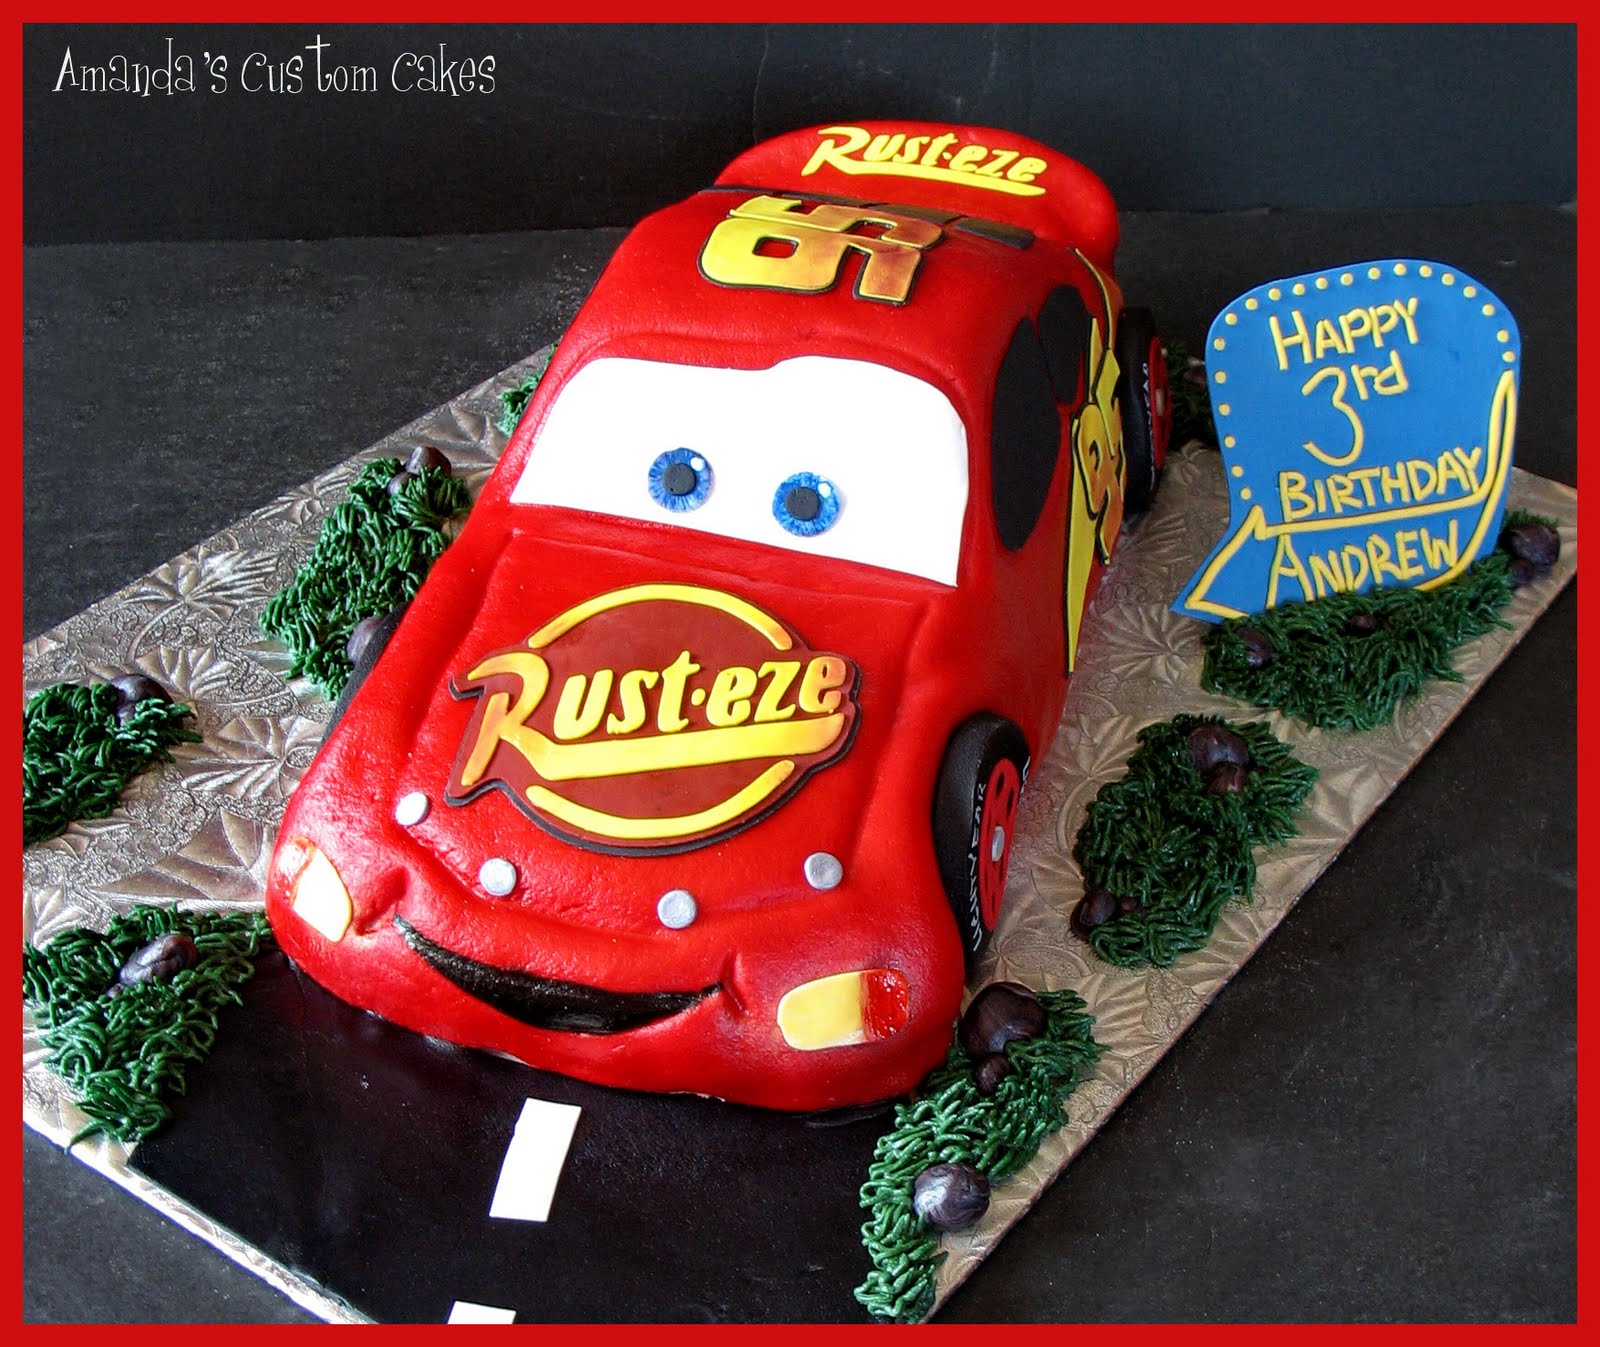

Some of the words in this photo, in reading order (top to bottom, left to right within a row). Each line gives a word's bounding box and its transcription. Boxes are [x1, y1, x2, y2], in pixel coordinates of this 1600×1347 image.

[1269, 297, 1419, 370] HAPPY
[1301, 349, 1409, 467] 3rd
[1279, 446, 1482, 522] BIRTHDAY
[1265, 519, 1459, 609] ANDREW
